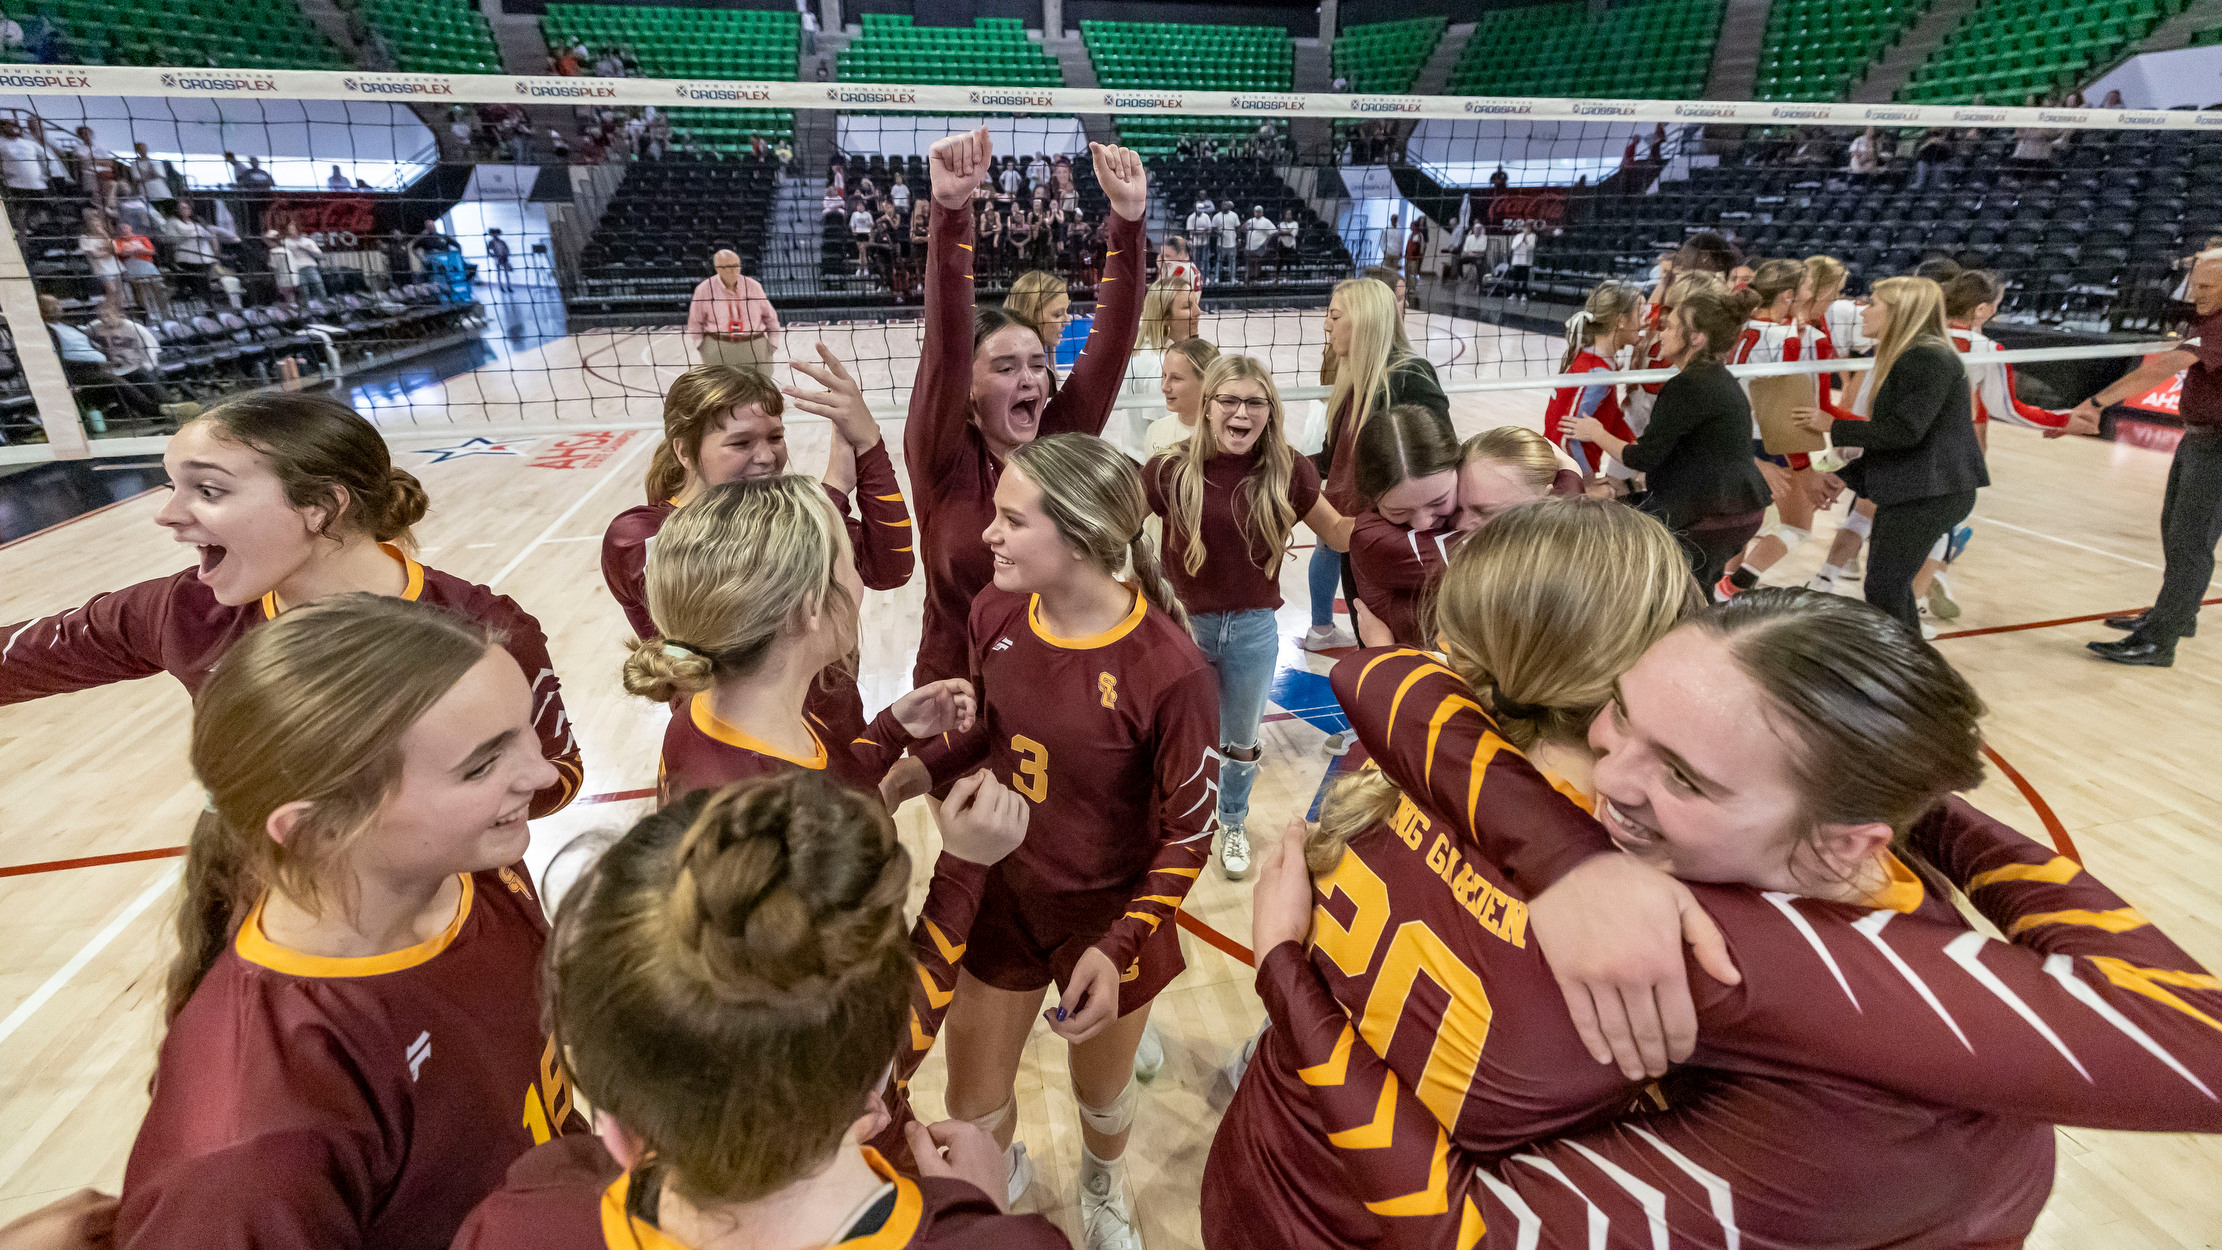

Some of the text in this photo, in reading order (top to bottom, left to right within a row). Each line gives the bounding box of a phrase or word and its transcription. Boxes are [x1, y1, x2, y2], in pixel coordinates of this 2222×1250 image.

[0, 75, 91, 88] ROSSPLEX
[179, 79, 278, 91] CROSSPLEX
[360, 83, 453, 95] CROSSPLEX
[531, 86, 616, 98] CROSSPLEX
[690, 90, 770, 101] CROSSPLEX
[840, 92, 916, 103] CROSSPLEX
[982, 95, 1053, 106] CROSSPLEX
[1116, 98, 1183, 108] CROSSPLEX
[1241, 101, 1305, 110] CROSSPLEX
[1360, 103, 1421, 113] CROSSPLEX
[1474, 105, 1531, 114] CROSSPLEX
[303, 230, 358, 247] ero
[525, 431, 614, 470] AHSA
[1010, 733, 1049, 804] 3
